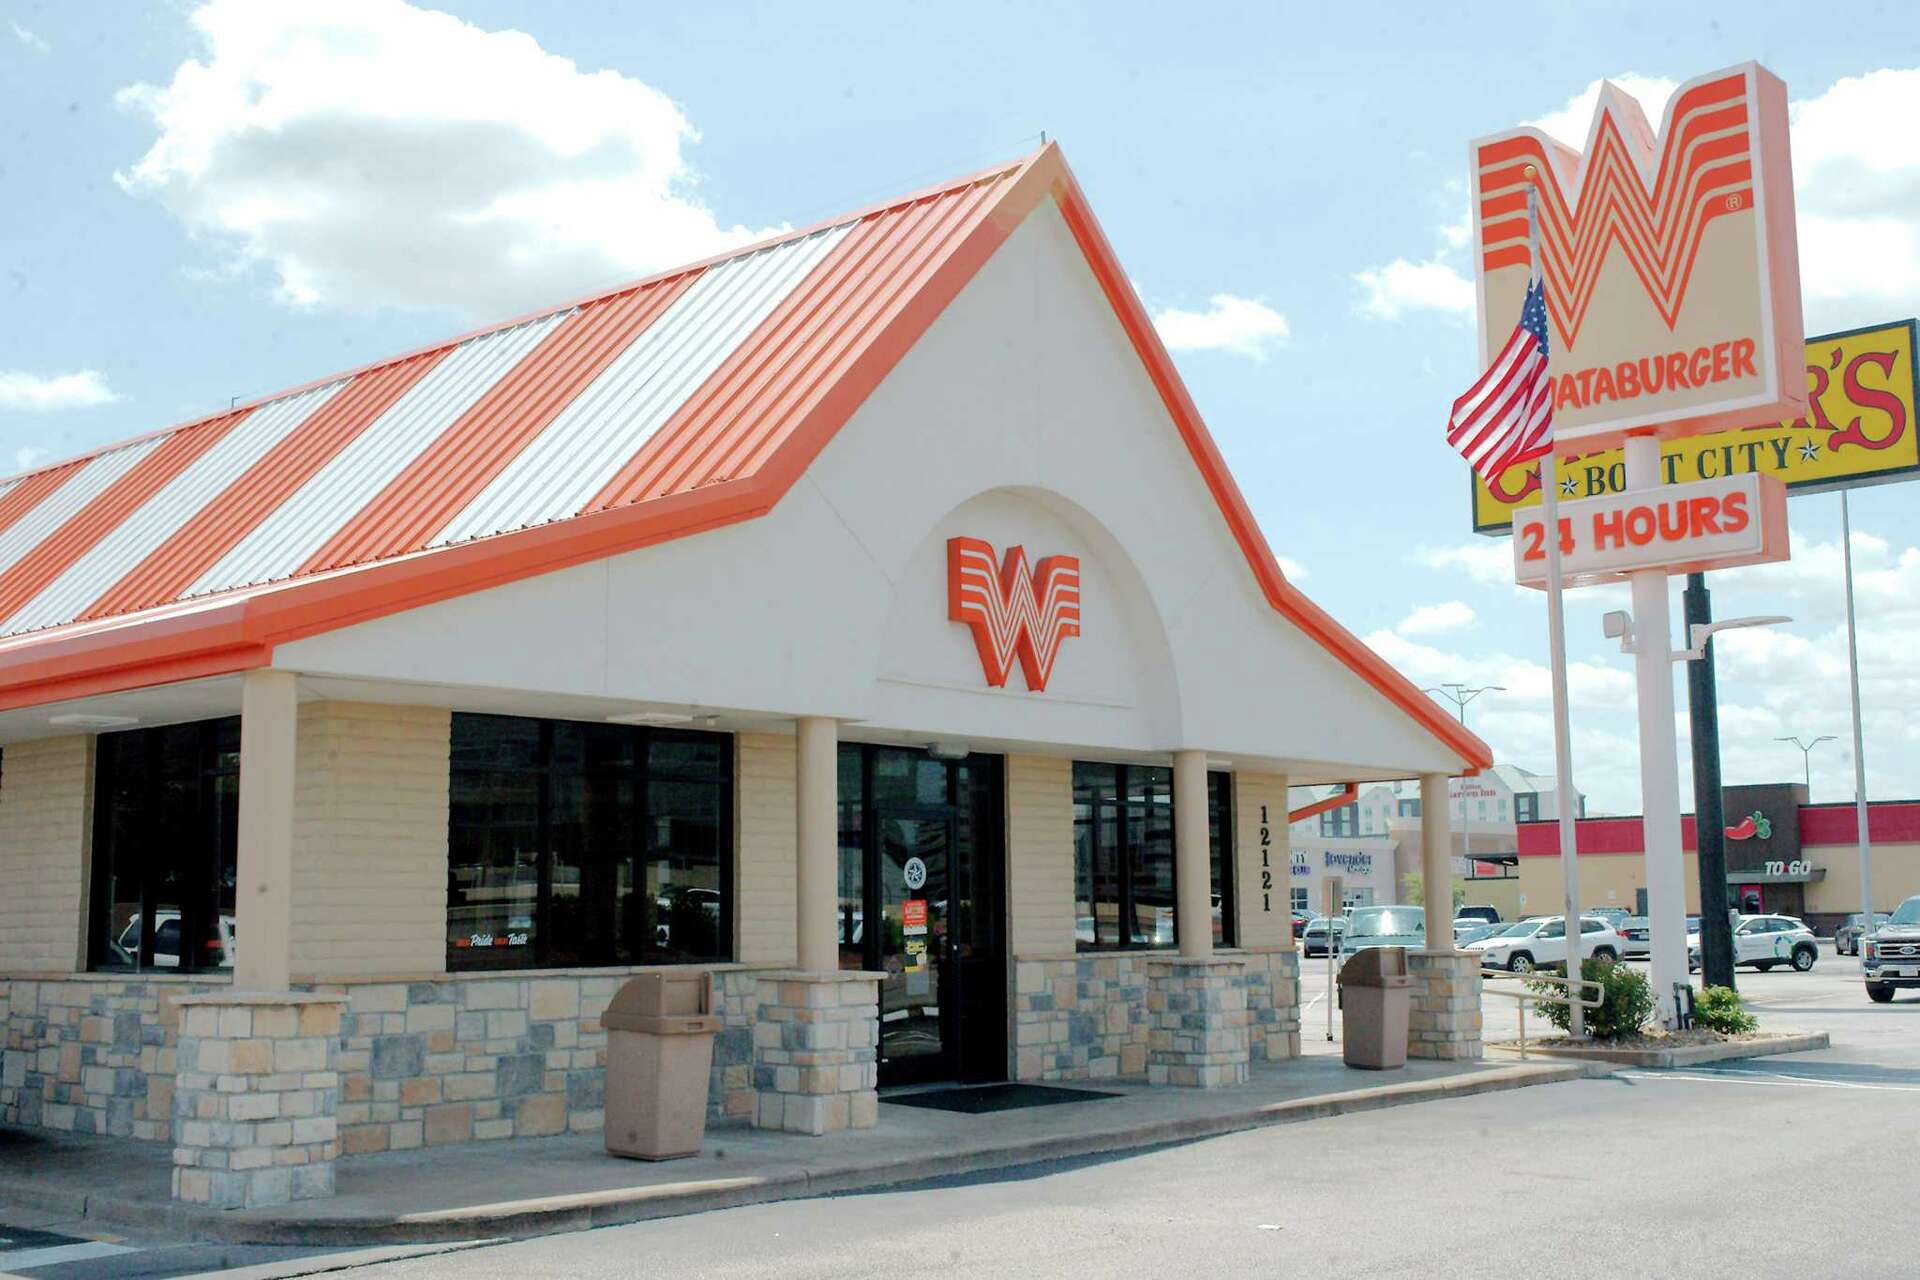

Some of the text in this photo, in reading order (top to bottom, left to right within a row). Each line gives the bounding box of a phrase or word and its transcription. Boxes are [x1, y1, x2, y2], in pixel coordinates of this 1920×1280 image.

[1584, 453, 1683, 497] BOT
[1697, 437, 1793, 479] CITY
[1593, 492, 1750, 551] HOURS
[1260, 805, 1272, 911] 12121
[1765, 860, 1811, 876] TO GO
